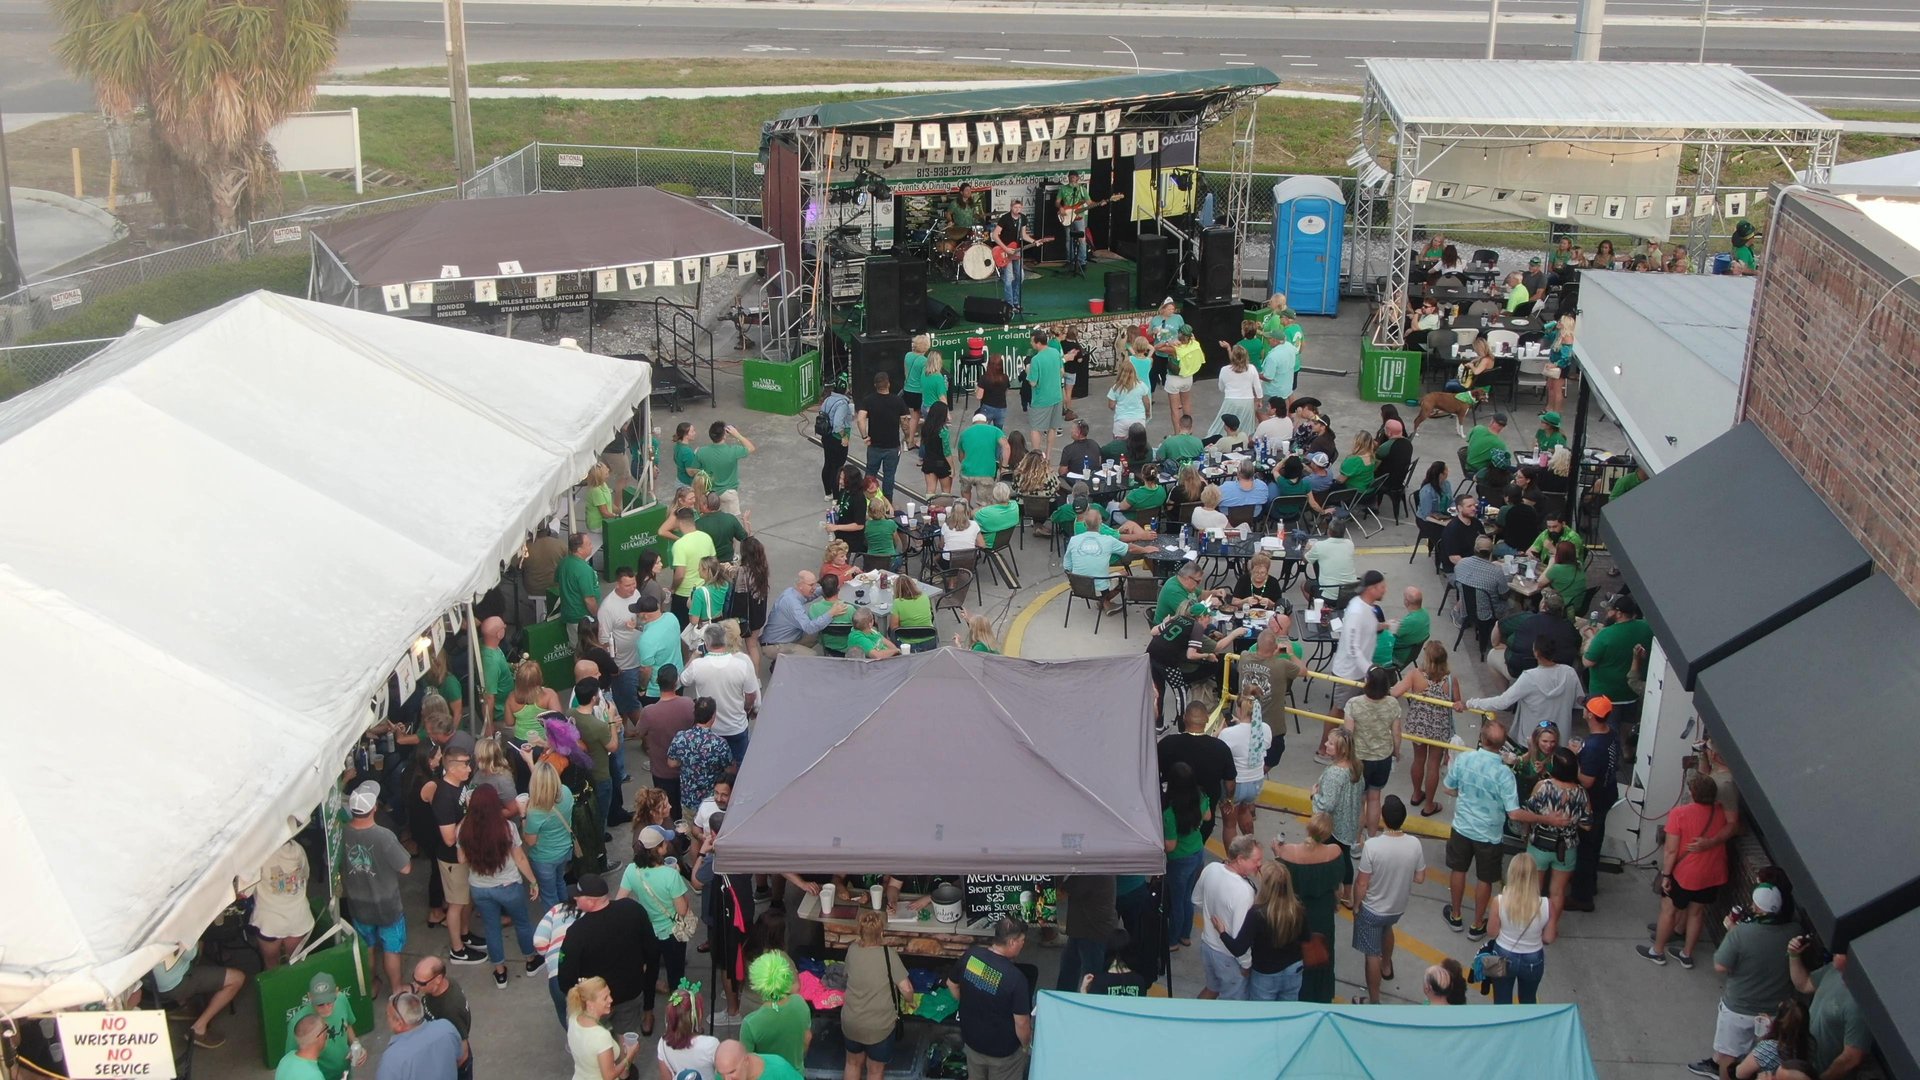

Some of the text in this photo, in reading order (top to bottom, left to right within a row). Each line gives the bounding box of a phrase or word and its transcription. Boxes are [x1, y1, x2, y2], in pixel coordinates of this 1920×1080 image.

[1160, 132, 1196, 146] OASTAL
[917, 166, 972, 178] 813-938-5282
[898, 182, 920, 192] Events
[920, 181, 927, 190] &
[929, 181, 950, 192] Dining
[973, 178, 1007, 188] Beverages
[1008, 177, 1014, 186] &
[1015, 176, 1028, 185] Hot
[489, 297, 524, 306] STAINLESS
[545, 294, 573, 302] SCRATCH
[437, 303, 465, 311] BONDED
[501, 300, 589, 313] STAIN REMOVAL SPECIALIST
[437, 310, 467, 318] INSURED
[931, 336, 961, 348] Direct
[998, 330, 1031, 340] Ireland
[629, 531, 650, 541] SALTY
[620, 535, 658, 550] SHAMROCK
[1163, 624, 1183, 641] 9
[1242, 663, 1271, 673] CALIENTE
[967, 874, 1052, 884] MERCHANDISE
[968, 885, 992, 894] SHORT
[986, 893, 1006, 903] $25
[971, 904, 992, 912] LONG
[987, 912, 1006, 922] $35
[101, 1017, 126, 1031] NO
[74, 1033, 158, 1046] WRISTBAND
[107, 1048, 132, 1061] NO
[95, 1063, 150, 1075] SERVICE
